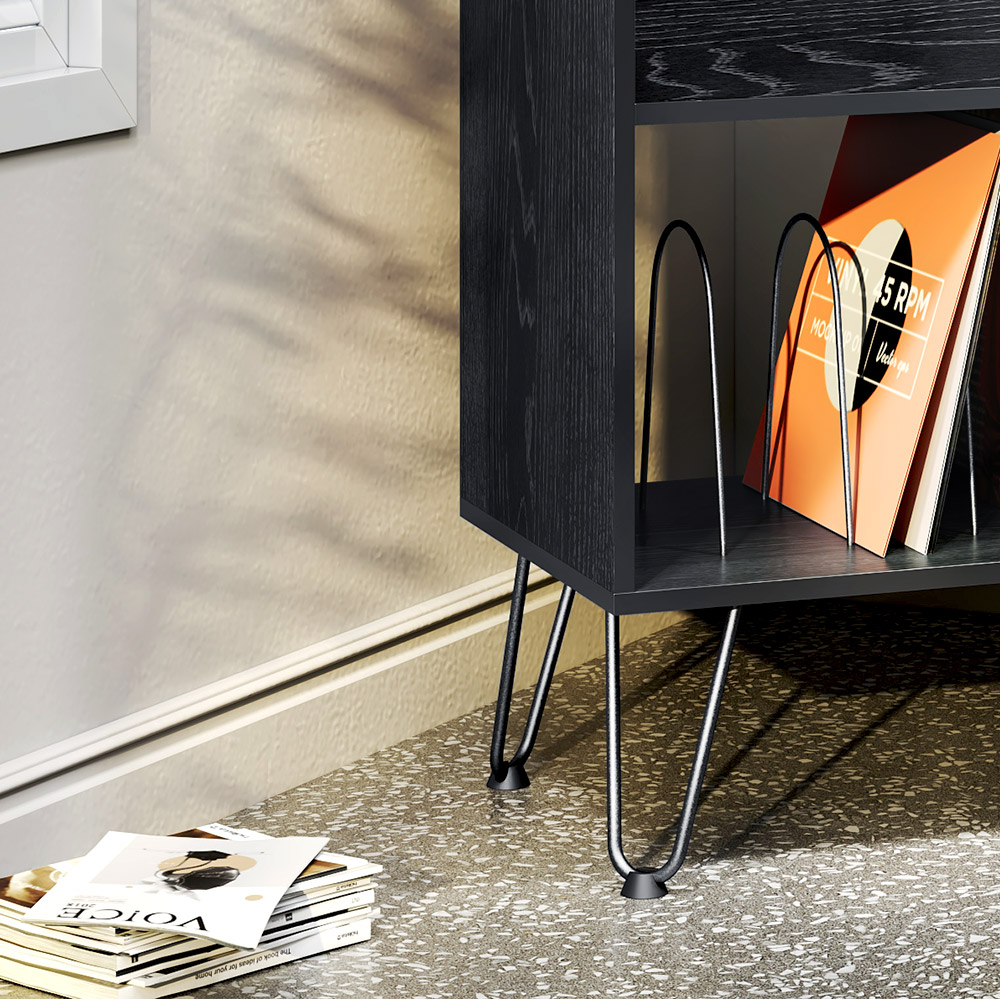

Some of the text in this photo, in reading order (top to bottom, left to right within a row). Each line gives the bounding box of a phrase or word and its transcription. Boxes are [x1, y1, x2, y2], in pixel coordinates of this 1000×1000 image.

[872, 274, 896, 307] 45
[893, 281, 931, 322] RPM
[255, 956, 263, 964] of
[264, 951, 279, 960] book
[239, 958, 256, 968] ideas
[214, 965, 228, 975] your
